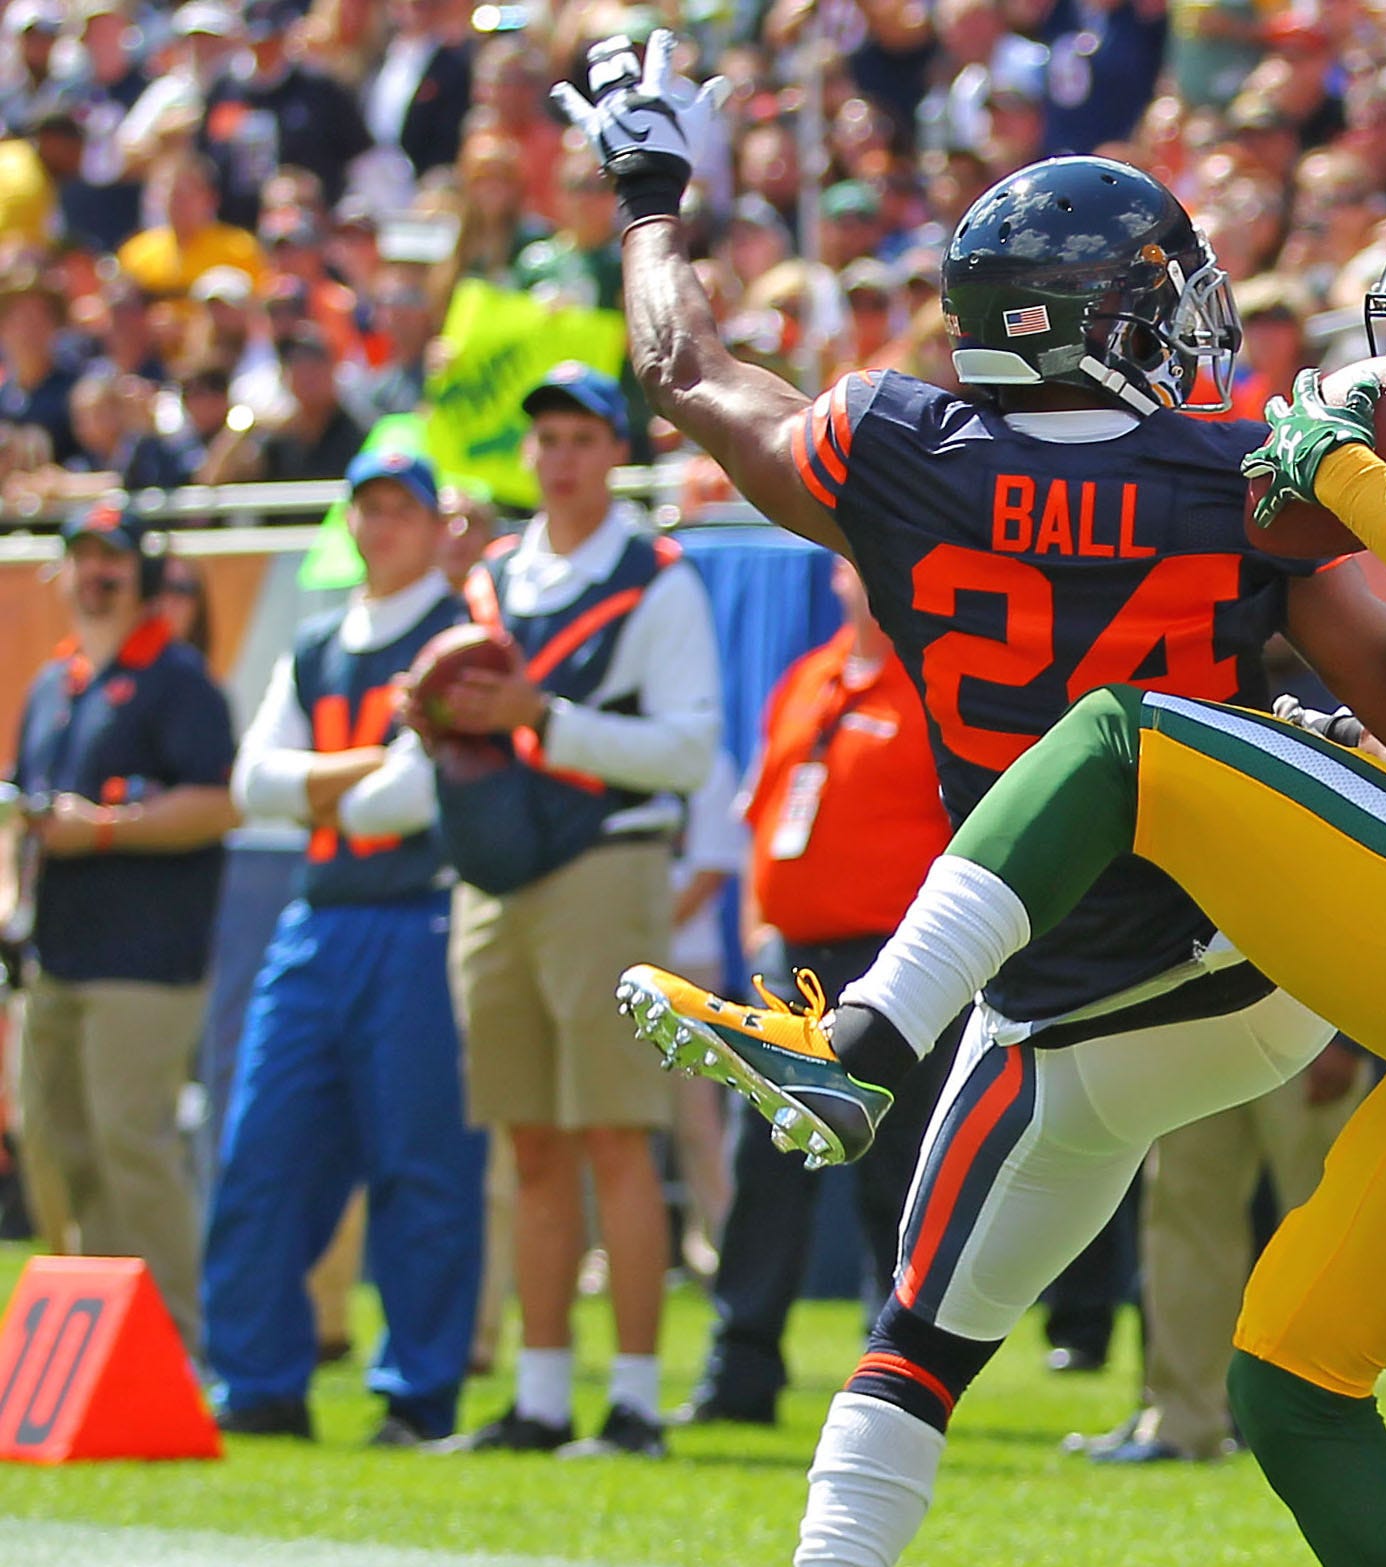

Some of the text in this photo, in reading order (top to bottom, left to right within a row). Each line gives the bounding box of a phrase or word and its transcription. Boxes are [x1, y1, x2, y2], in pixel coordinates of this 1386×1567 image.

[992, 474, 1157, 559] BALL
[911, 543, 1243, 772] 24
[0, 1297, 105, 1445] 10
